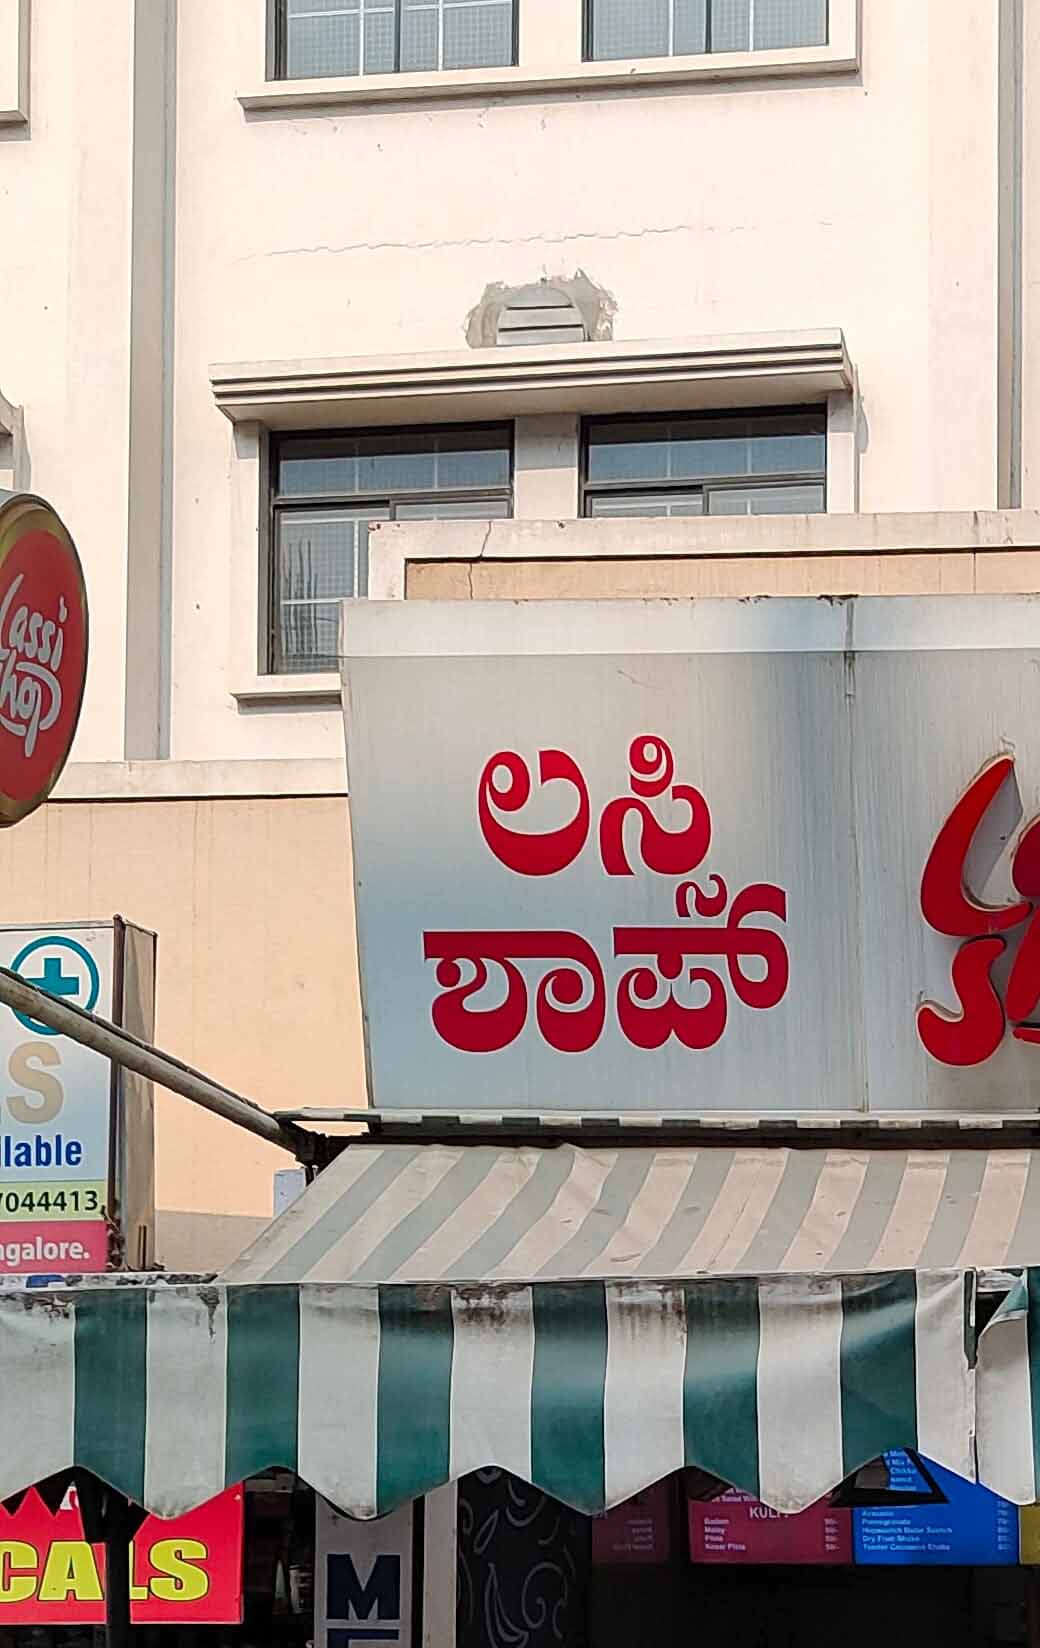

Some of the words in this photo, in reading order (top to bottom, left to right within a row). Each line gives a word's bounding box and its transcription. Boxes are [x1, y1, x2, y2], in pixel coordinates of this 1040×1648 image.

[477, 734, 729, 919] ಲಸ್ಸಿ
[422, 882, 790, 1054] ಶಾಪ್
[0, 1189, 99, 1213] 044413
